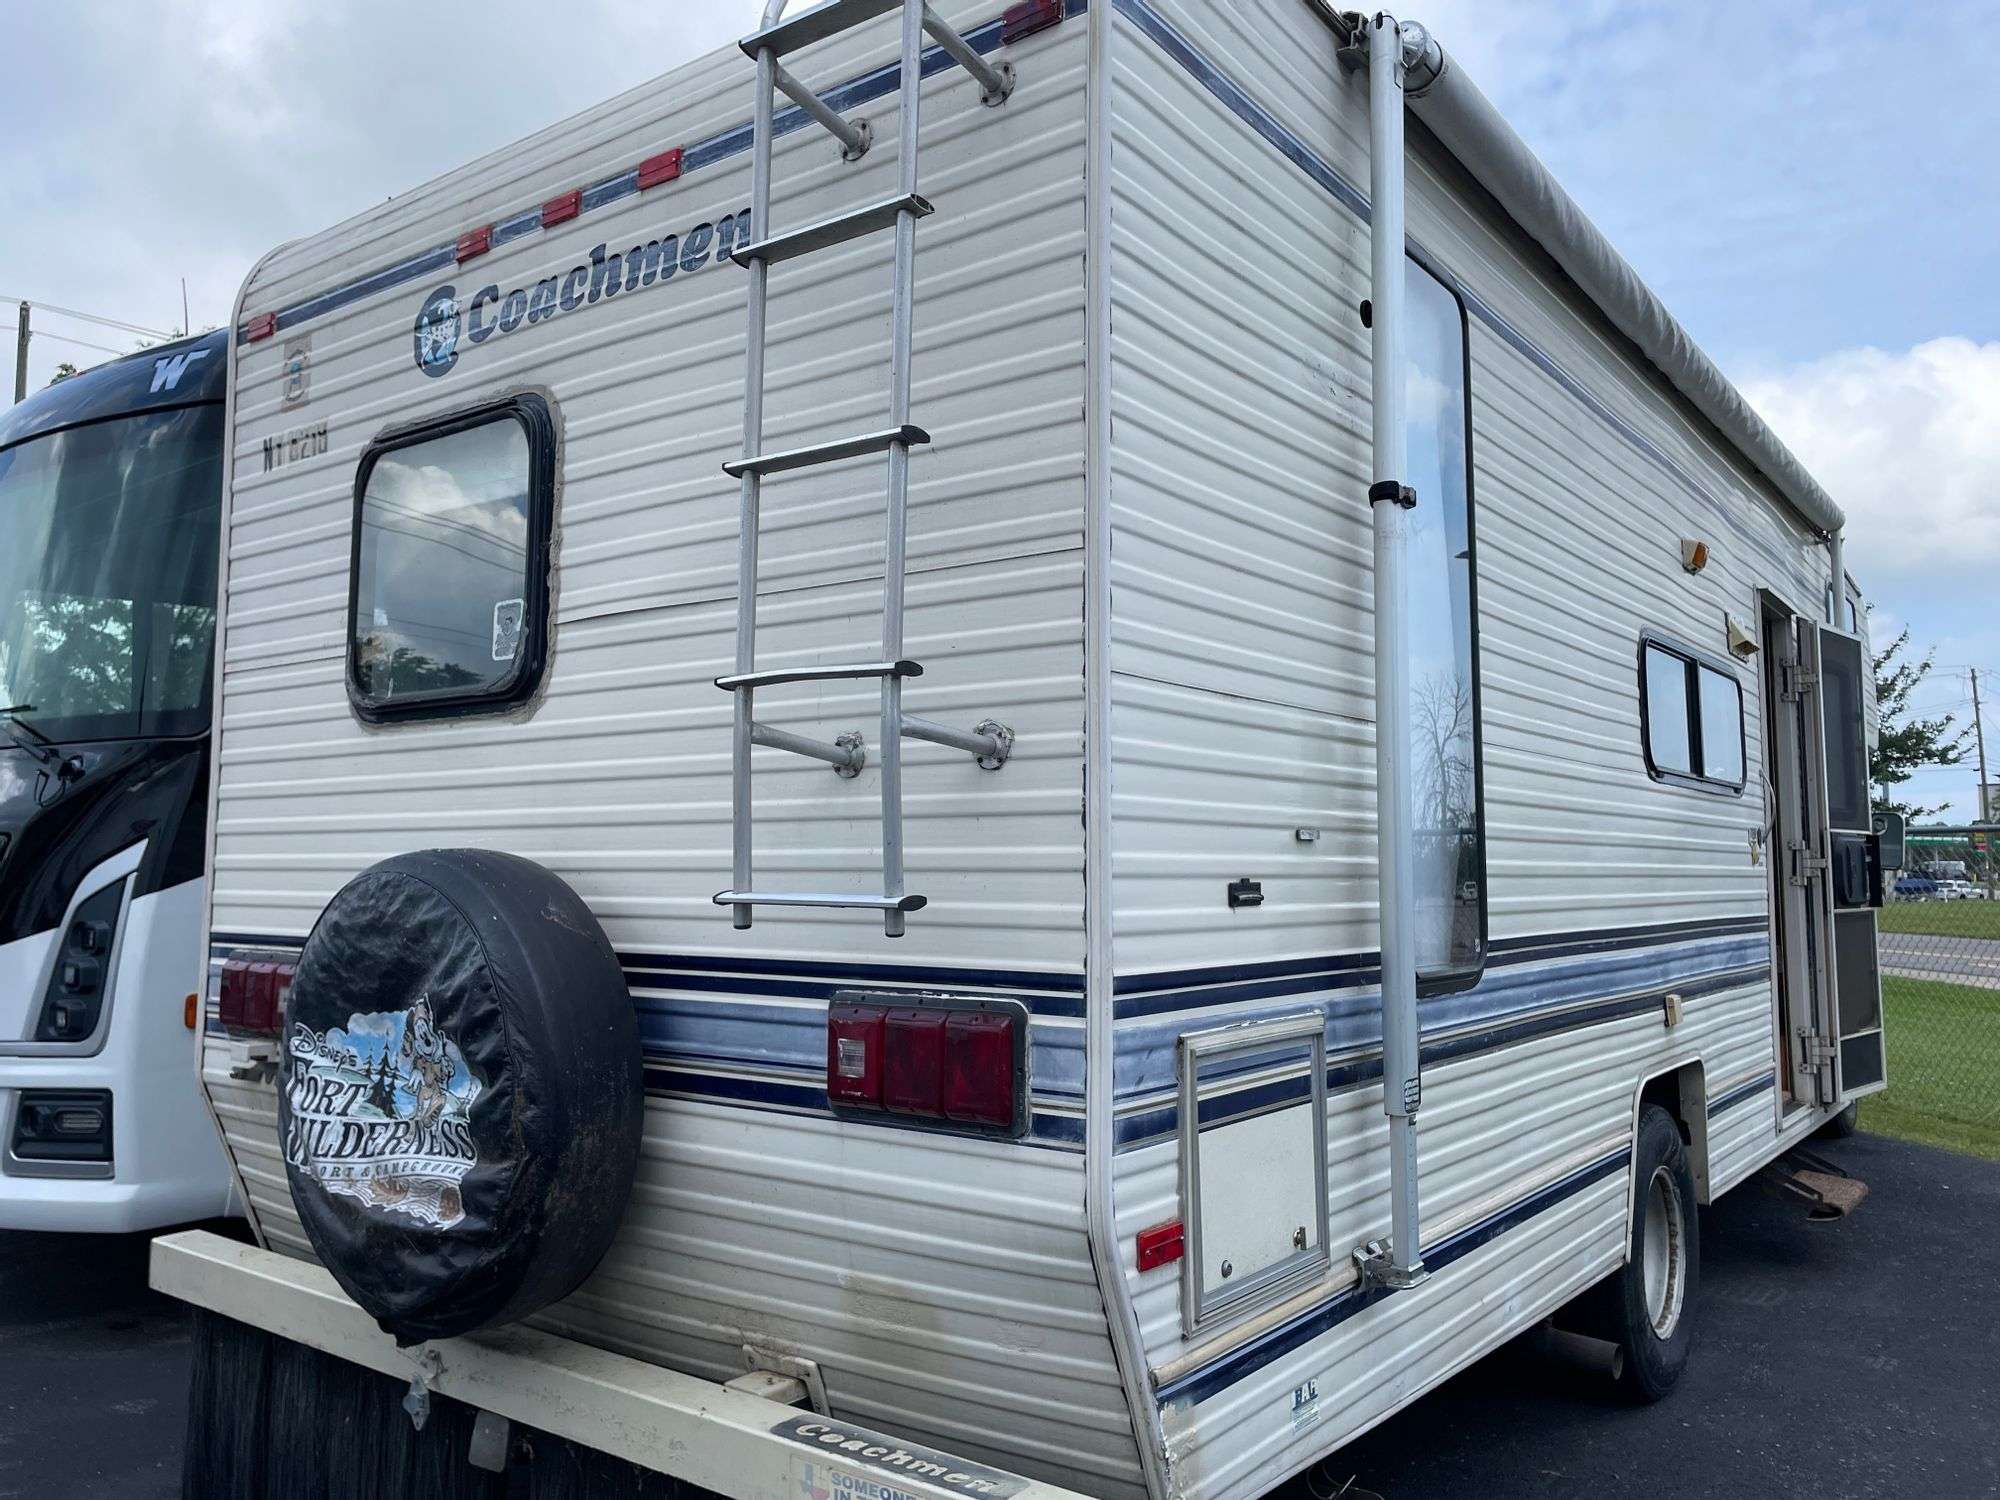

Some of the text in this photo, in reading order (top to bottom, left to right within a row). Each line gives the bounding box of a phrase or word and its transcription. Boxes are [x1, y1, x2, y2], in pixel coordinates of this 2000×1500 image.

[468, 207, 754, 344] Coachmen
[288, 1057, 369, 1117] FORT
[795, 1423, 1002, 1493] Coachmen
